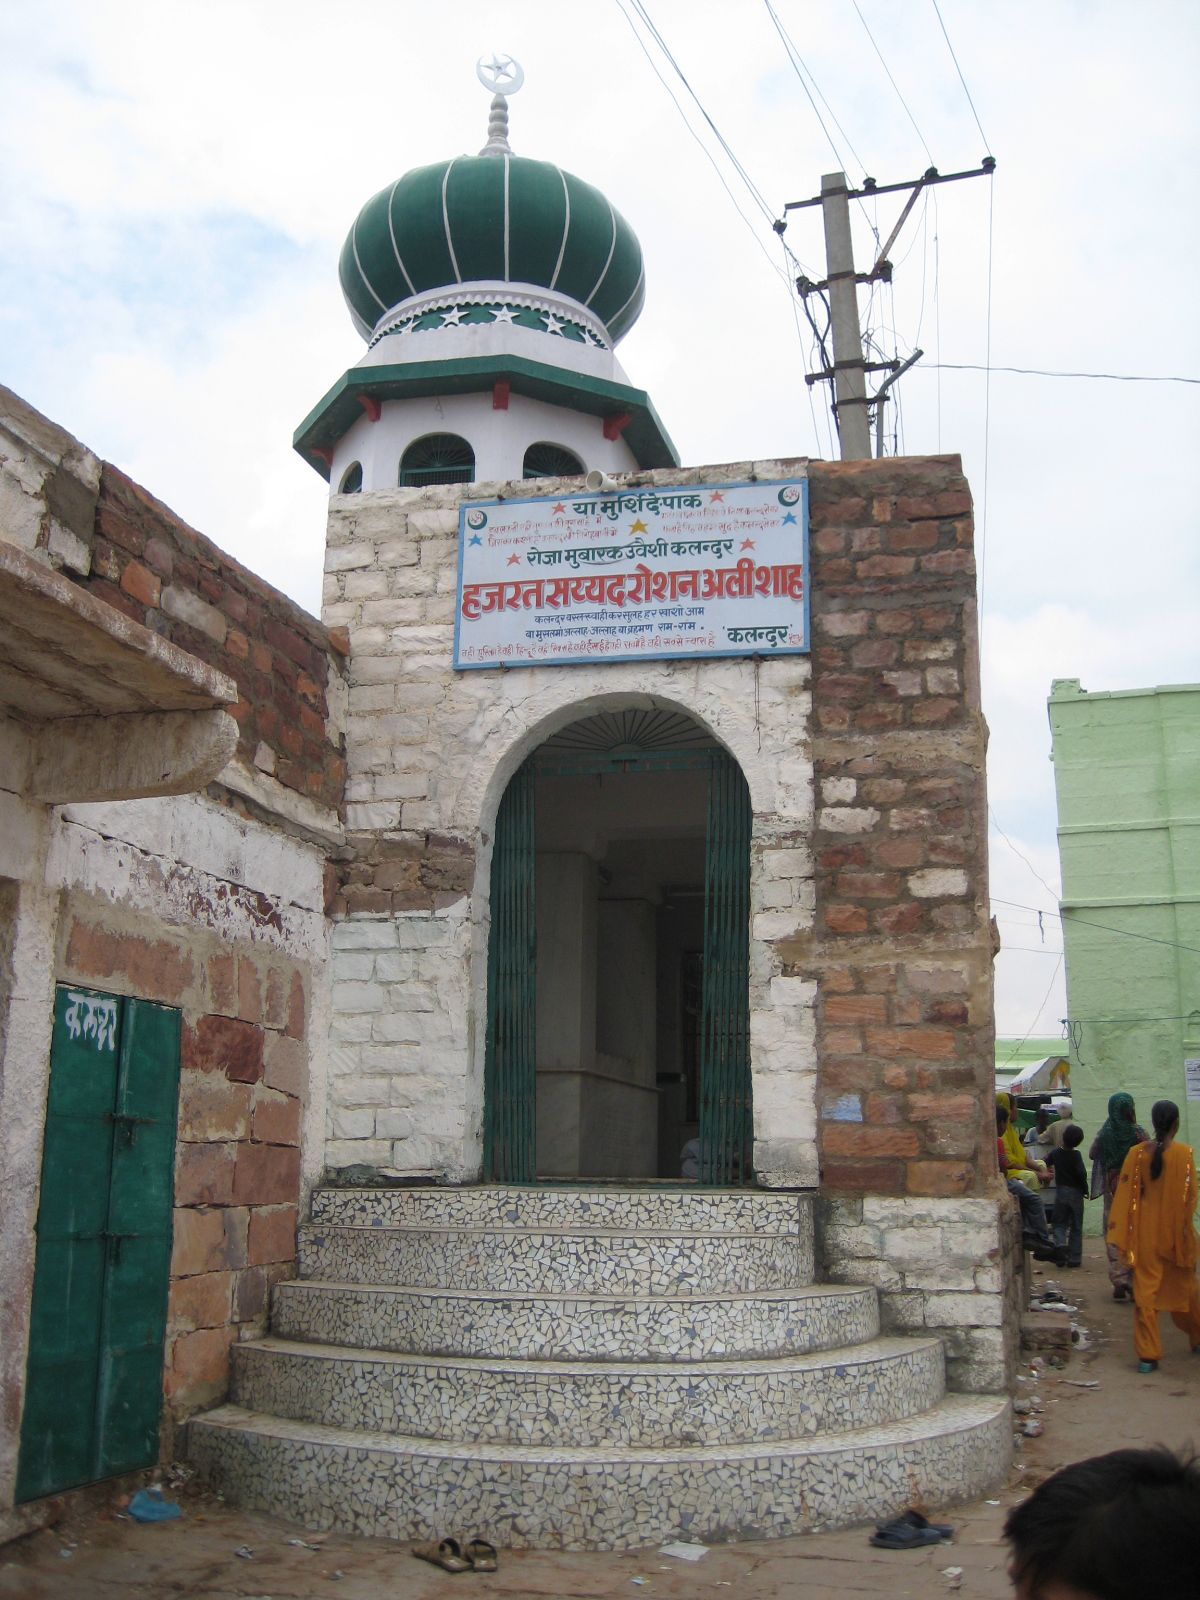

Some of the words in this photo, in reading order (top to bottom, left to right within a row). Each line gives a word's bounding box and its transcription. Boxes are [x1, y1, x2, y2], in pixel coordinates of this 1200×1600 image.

[573, 501, 597, 515] या
[564, 546, 623, 569] मुबारक
[671, 538, 734, 560] कलन्दर
[461, 579, 545, 621] हजरत
[626, 562, 700, 604] रोशन
[701, 557, 755, 599] अली
[755, 564, 803, 601] शाह
[685, 606, 705, 617] आम
